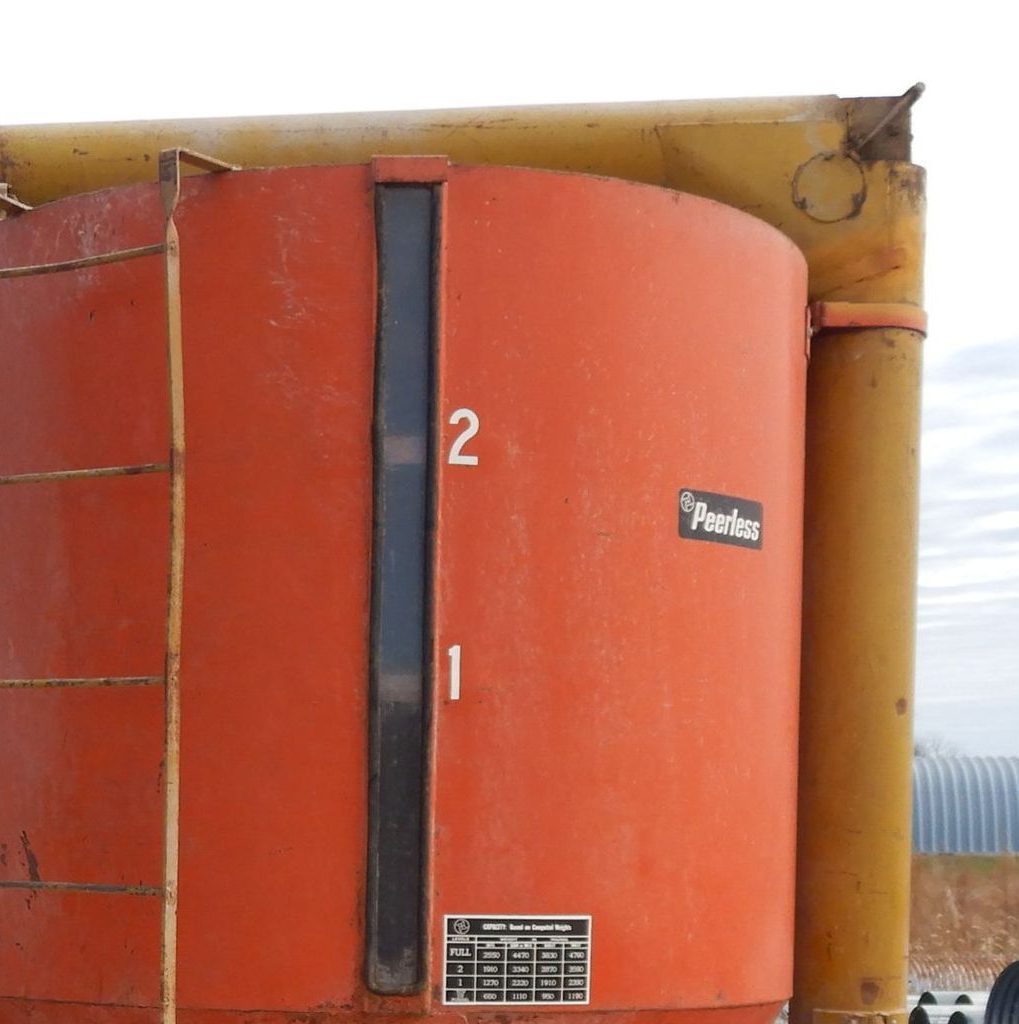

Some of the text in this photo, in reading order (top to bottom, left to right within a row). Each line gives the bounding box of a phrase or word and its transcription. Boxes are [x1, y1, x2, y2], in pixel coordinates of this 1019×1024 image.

[448, 408, 479, 466] 2
[691, 501, 760, 541] Peerless
[448, 645, 461, 700] 1
[449, 948, 472, 957] FULL
[457, 965, 464, 973] 2
[482, 979, 499, 987] 1270
